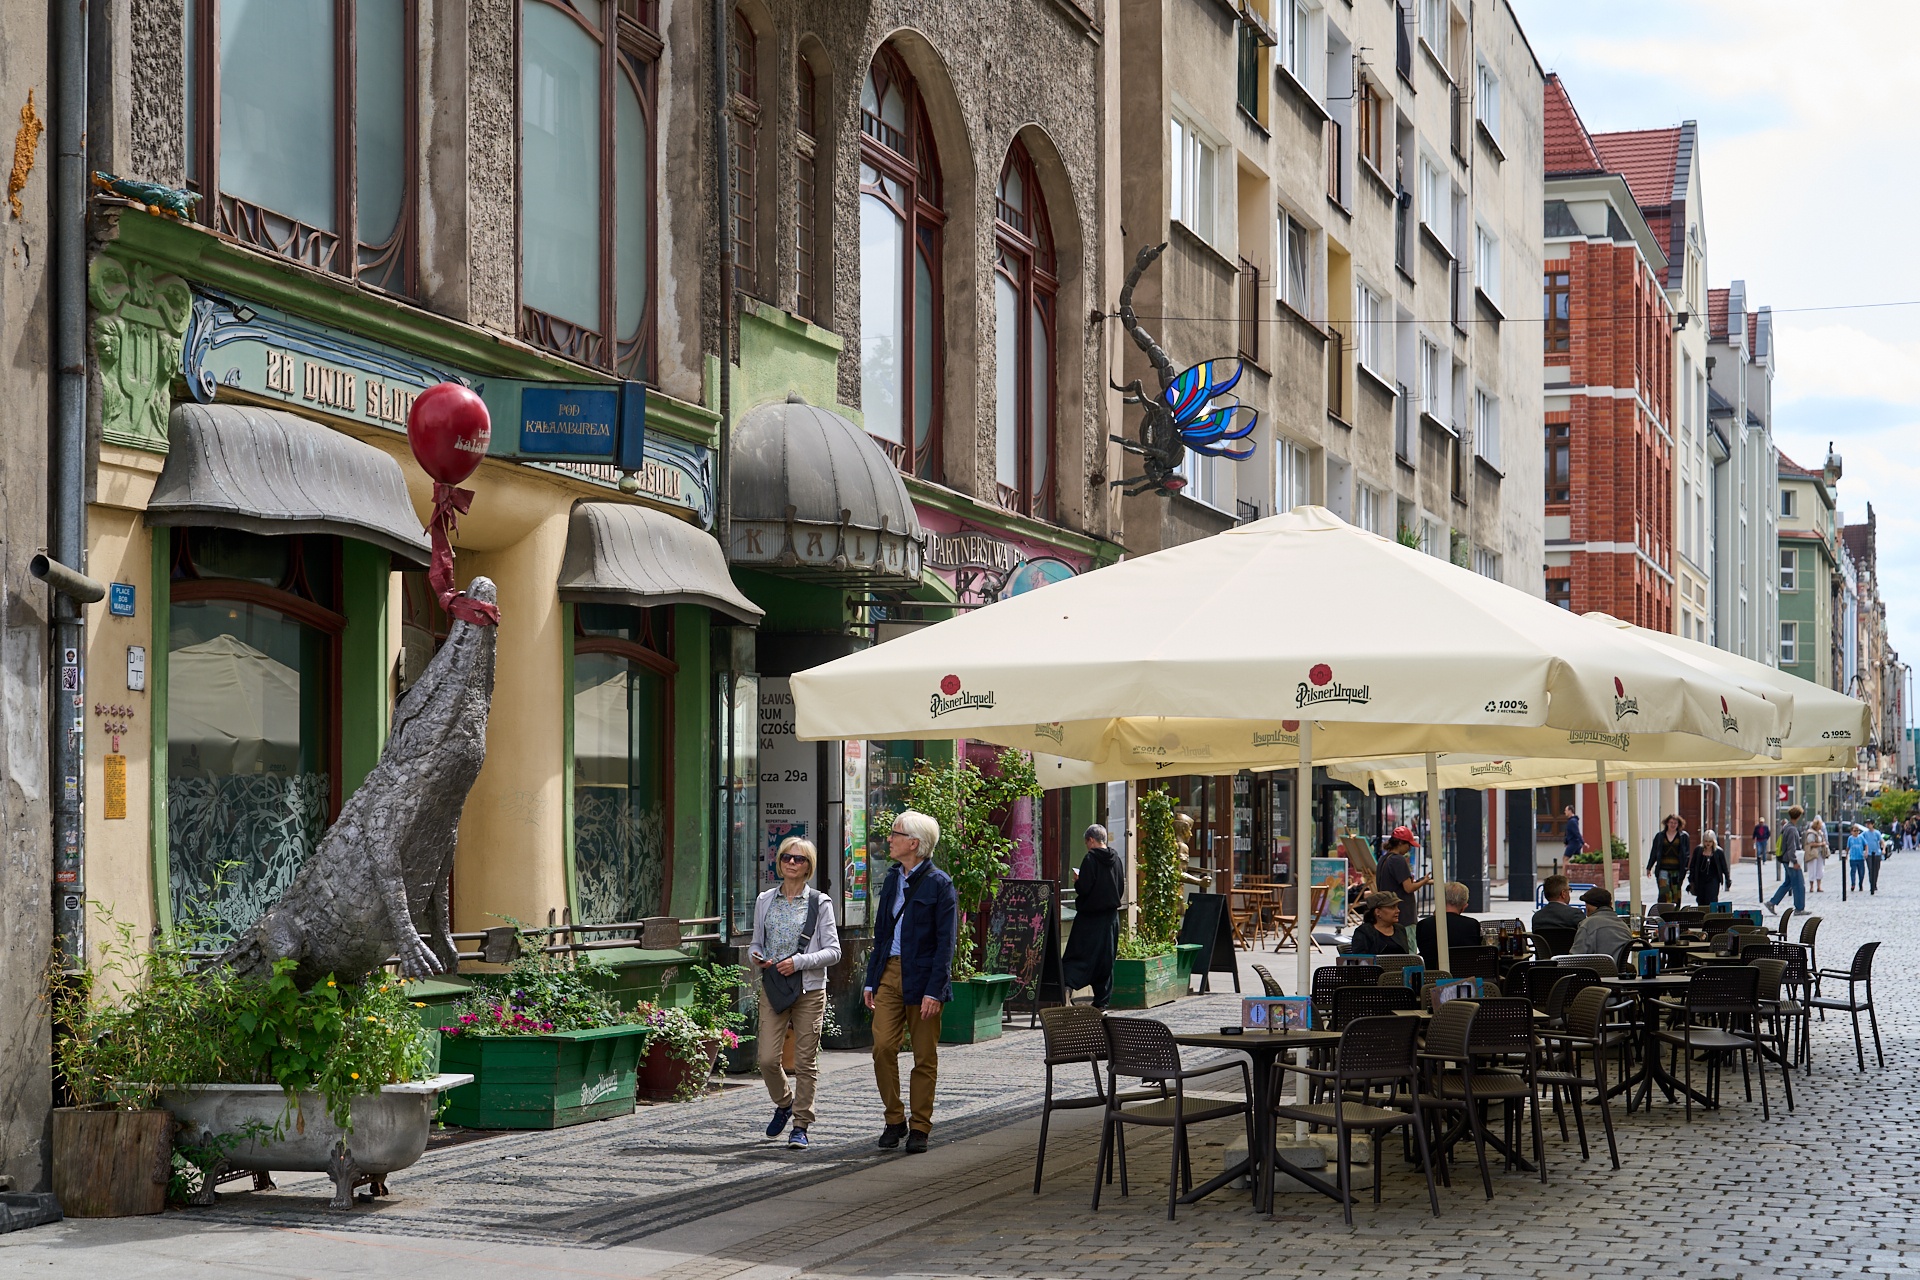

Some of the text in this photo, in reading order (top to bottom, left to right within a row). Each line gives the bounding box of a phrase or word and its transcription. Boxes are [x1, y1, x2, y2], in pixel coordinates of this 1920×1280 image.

[266, 350, 295, 394] ZA
[304, 361, 356, 411] DNIA
[559, 404, 580, 416] POD
[932, 534, 1009, 570] PARTNERSTWA
[116, 587, 130, 595] PLACE
[114, 603, 132, 611] MARLEY
[1499, 700, 1528, 710] 100%
[784, 770, 808, 782] 29a
